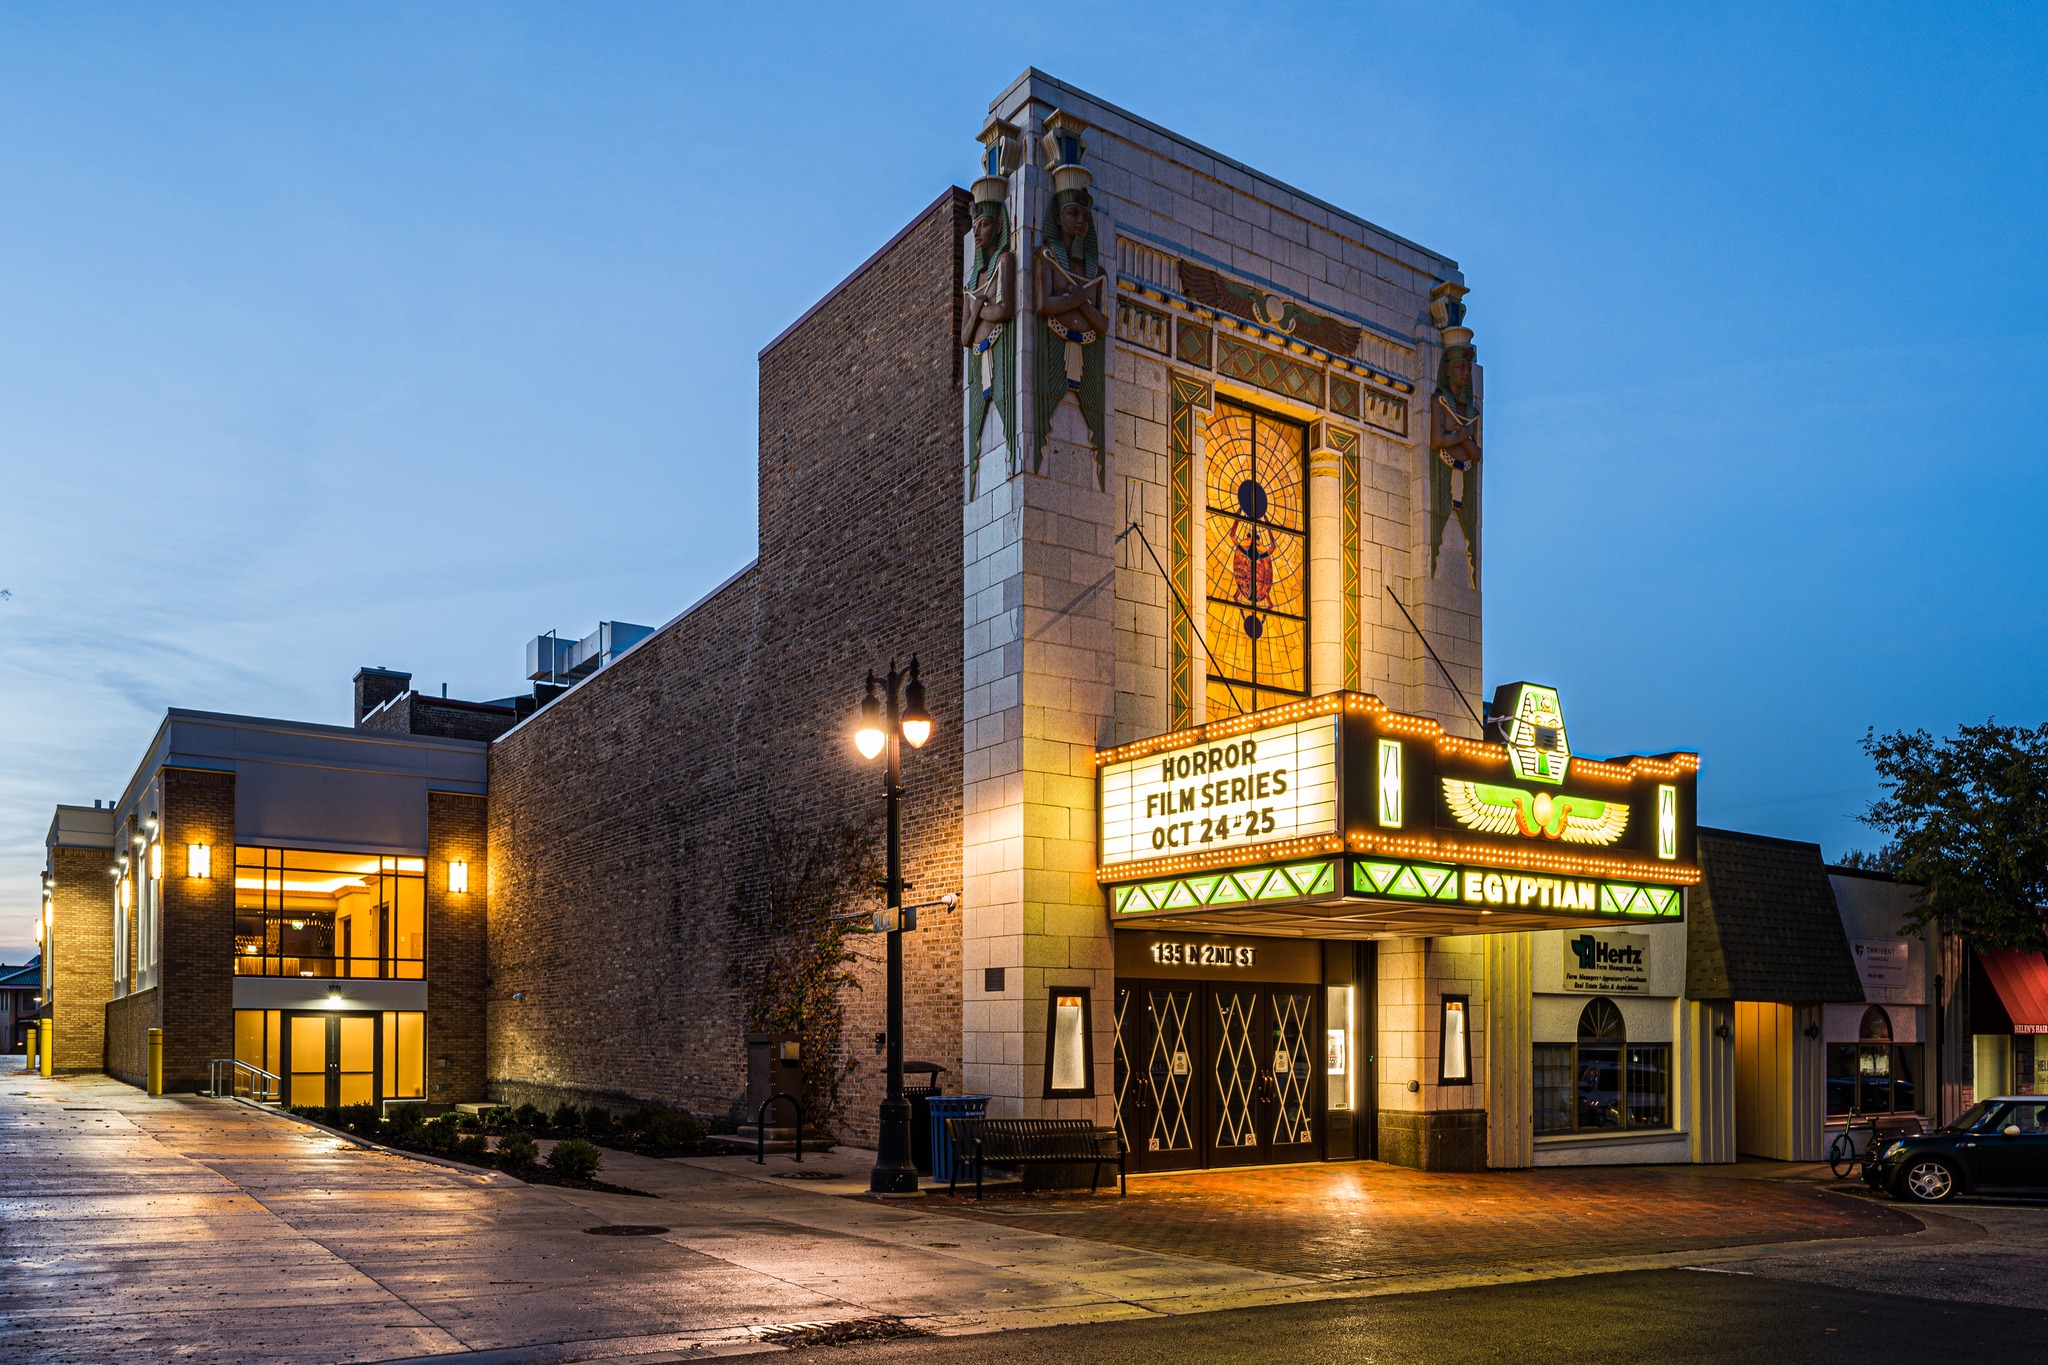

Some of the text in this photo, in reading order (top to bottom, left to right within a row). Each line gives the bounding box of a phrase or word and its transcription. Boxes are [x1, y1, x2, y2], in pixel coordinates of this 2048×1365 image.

[1162, 739, 1257, 783] HORROR
[1146, 768, 1287, 818] FILM SERIES
[1152, 806, 1276, 850] OCT 24-25
[1464, 871, 1596, 911] EGYPTIAN
[1154, 943, 1259, 966] 135 N 2ND ST
[1596, 941, 1642, 964] Hertz
[1866, 946, 1895, 955] THRIVENT
[2014, 1024, 2048, 1034] HELEN'S HAIR
